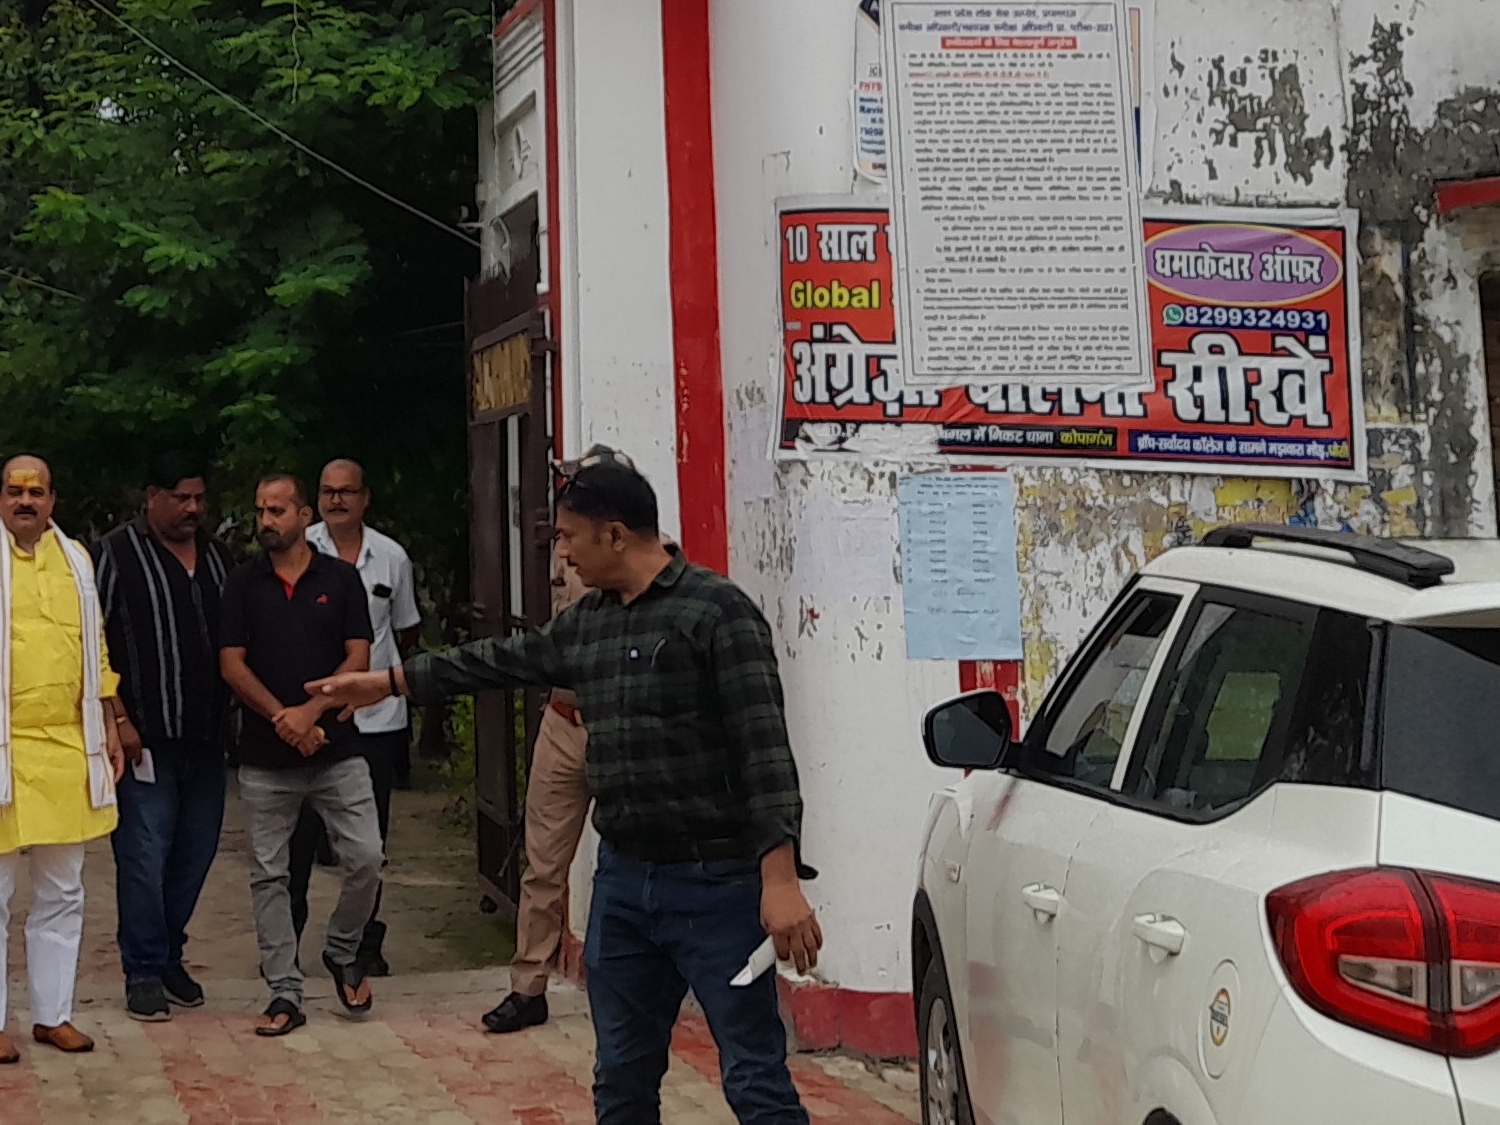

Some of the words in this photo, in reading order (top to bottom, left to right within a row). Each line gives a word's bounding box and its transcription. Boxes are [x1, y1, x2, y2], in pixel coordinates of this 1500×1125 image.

[785, 224, 809, 263] 10
[815, 223, 878, 262] साल
[1260, 246, 1324, 285] ऑफर
[790, 279, 880, 310] Global
[1184, 306, 1329, 331] 8299324931
[1157, 331, 1334, 429] सीखें
[1058, 427, 1115, 448] कोपागंज
